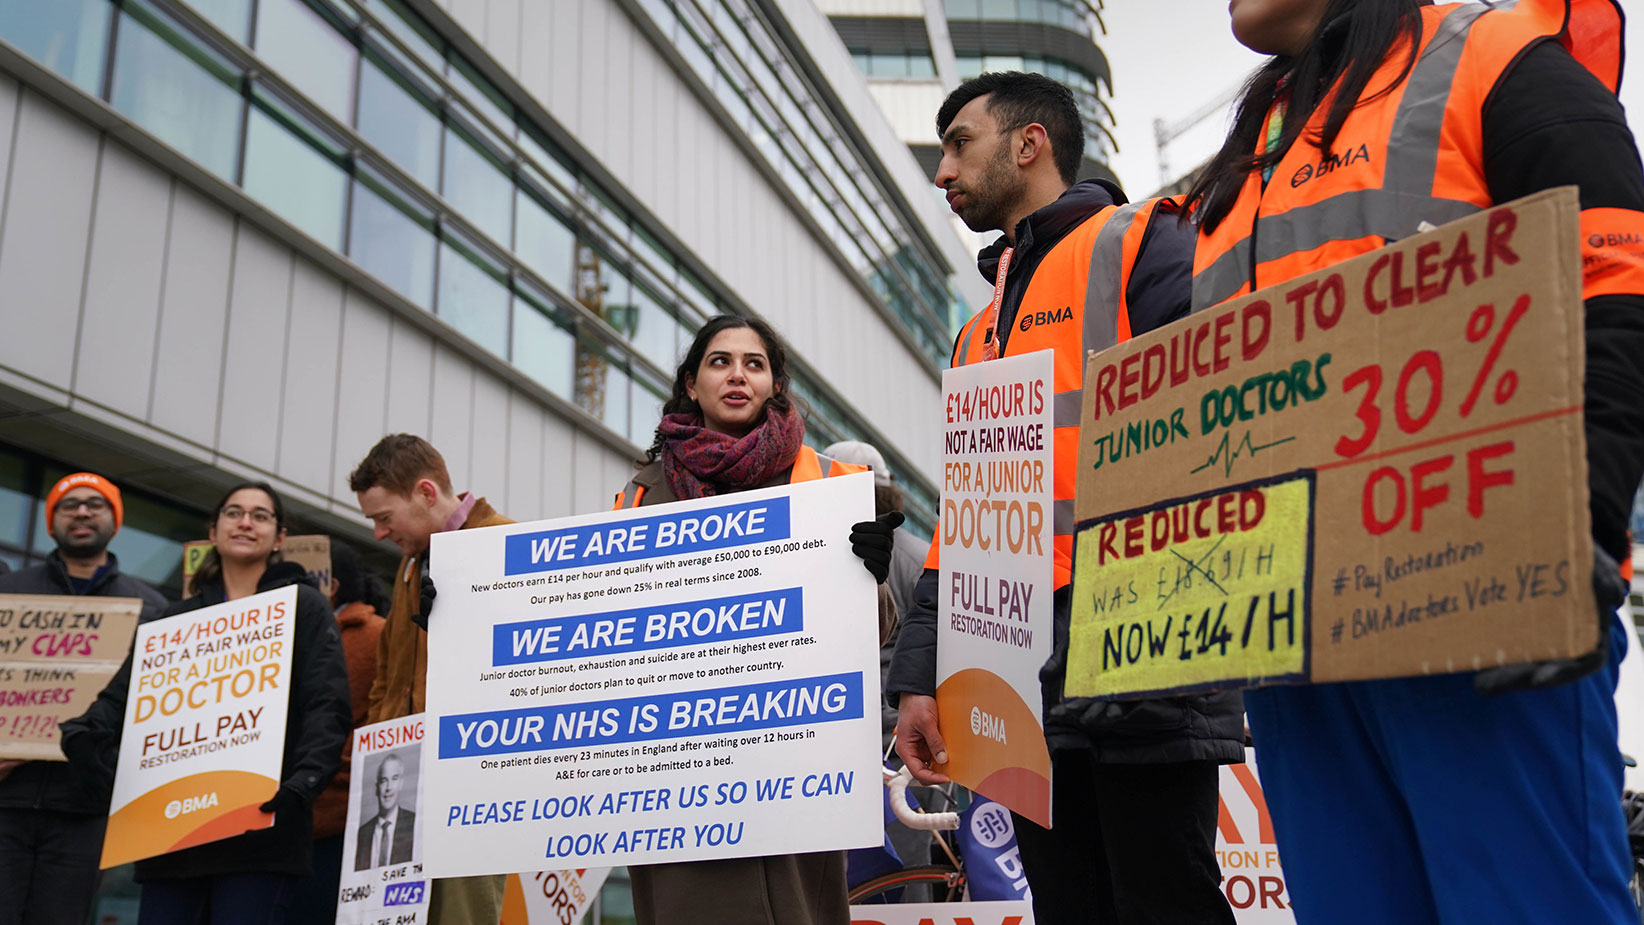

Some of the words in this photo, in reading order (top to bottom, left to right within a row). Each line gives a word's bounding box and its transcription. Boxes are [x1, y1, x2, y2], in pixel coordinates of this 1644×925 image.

[1315, 144, 1370, 178] BMA
[1035, 306, 1073, 326] BMA
[1094, 300, 1272, 421] REDUCED
[1285, 273, 1345, 342] TO
[1364, 207, 1521, 315] CLEAR
[1334, 293, 1532, 458] 30%
[947, 382, 1024, 424] £14/HOUR
[1029, 379, 1044, 415] IS
[1093, 408, 1189, 470] JUNIOR
[1200, 353, 1332, 436] DOCTORS
[946, 430, 967, 455] NOT
[969, 430, 977, 453] A
[979, 427, 1004, 453] FAIR
[1007, 424, 1044, 452] WAGE
[945, 462, 971, 492] FOR
[974, 462, 984, 492] A
[986, 460, 1044, 498] JUNIOR
[1362, 440, 1515, 536] OFF
[531, 534, 578, 564] WE
[583, 524, 648, 558] ARE
[655, 507, 768, 548] BROKE
[944, 498, 1044, 556] DOCTOR
[1099, 488, 1266, 566] REDUCED
[471, 584, 491, 593] New
[492, 579, 524, 591] doctors
[526, 578, 546, 587] earn
[548, 575, 563, 584] £14
[565, 573, 579, 583] per
[582, 569, 603, 580] hour
[605, 567, 621, 577] and
[624, 563, 654, 576] qualify
[656, 560, 675, 571] with
[678, 555, 712, 568] average
[714, 550, 750, 563] £50,000
[764, 541, 800, 556] £90,000
[802, 539, 827, 550] debt.
[530, 594, 546, 605] Our
[549, 593, 564, 604] pay
[566, 592, 581, 601] has
[583, 590, 605, 601] gone
[607, 586, 632, 596] down
[634, 583, 652, 592] 25%
[665, 578, 682, 588] real
[684, 575, 710, 586] terms
[712, 571, 735, 582] since
[737, 568, 762, 579] 2008.
[1464, 578, 1506, 611] Vote
[1516, 560, 1570, 602] YES
[951, 571, 994, 615] FULL
[999, 578, 1033, 623] PAY
[1092, 580, 1138, 615] WAS
[19, 610, 66, 629] CASH
[69, 613, 104, 629] IN
[145, 609, 260, 653] £14/HOUR
[266, 602, 285, 622] IS
[512, 626, 562, 657] WE
[567, 617, 636, 651] ARE
[643, 597, 786, 642] BROKEN
[951, 613, 1008, 642] RESTORATION
[1010, 627, 1032, 649] NOW
[31, 633, 98, 657] CLAPS
[141, 651, 174, 671] NOT
[179, 647, 191, 662] A
[195, 637, 231, 657] FAIR
[236, 623, 284, 647] WAGE
[480, 672, 506, 682] Junior
[508, 668, 536, 679] doctor
[538, 664, 576, 675] burnout,
[579, 659, 626, 672] exhaustion
[628, 656, 645, 665] and
[648, 652, 678, 663] suicide
[680, 651, 695, 660] are
[697, 649, 706, 658] at
[708, 646, 730, 657] their
[733, 641, 766, 655] highest
[768, 640, 789, 649] ever
[790, 636, 817, 647] rates.
[1103, 616, 1172, 671] NOW
[24, 669, 76, 682] THINK
[138, 667, 179, 693] FOR
[185, 663, 200, 680] A
[204, 641, 283, 678] JUNIOR
[509, 687, 528, 697] 40%
[530, 686, 539, 695] of
[540, 683, 567, 696] junior
[569, 680, 602, 691] doctors
[604, 679, 623, 689] plan
[625, 677, 635, 686] to
[637, 674, 655, 686] quit
[657, 674, 667, 683] or
[669, 671, 694, 681] move
[708, 665, 744, 676] another
[746, 660, 784, 674] country.
[134, 663, 281, 724] DOCTOR
[142, 722, 208, 756] FULL
[216, 706, 264, 737] PAY
[358, 721, 425, 752] MISSING
[457, 715, 544, 749] YOUR
[552, 708, 620, 741] NHS
[628, 704, 659, 734] IS
[668, 683, 847, 730] BREAKING
[982, 712, 1006, 745] BMA
[139, 739, 227, 770] RESTORATION
[230, 731, 262, 748] NOW
[481, 760, 498, 769] One
[500, 757, 531, 769] patient
[534, 755, 551, 765] dies
[553, 754, 578, 764] every
[580, 752, 591, 761] 23
[593, 748, 629, 760] minutes
[642, 743, 678, 757] England
[679, 740, 701, 751] after
[704, 737, 738, 749] waiting
[740, 735, 761, 745] over
[764, 733, 775, 743] 12
[777, 731, 803, 742] hours
[806, 729, 815, 739] in
[555, 770, 575, 780] A&E
[576, 769, 589, 778] for
[591, 769, 611, 777] care
[625, 767, 634, 775] to
[636, 763, 648, 773] be
[650, 760, 691, 773] admitted
[713, 755, 733, 767] bed.
[182, 792, 219, 814] BMA
[447, 800, 526, 827] PLEASE
[532, 794, 595, 820] LOOK
[598, 788, 671, 816] AFTER
[678, 785, 709, 809] US
[715, 781, 747, 805] SO
[756, 776, 795, 801] WE
[801, 771, 854, 797] CAN
[545, 832, 608, 858] LOOK
[612, 827, 686, 853] AFTER
[694, 822, 744, 847] YOU
[382, 866, 407, 881] SAVE
[568, 878, 586, 907] FOR
[386, 886, 422, 904] NHS
